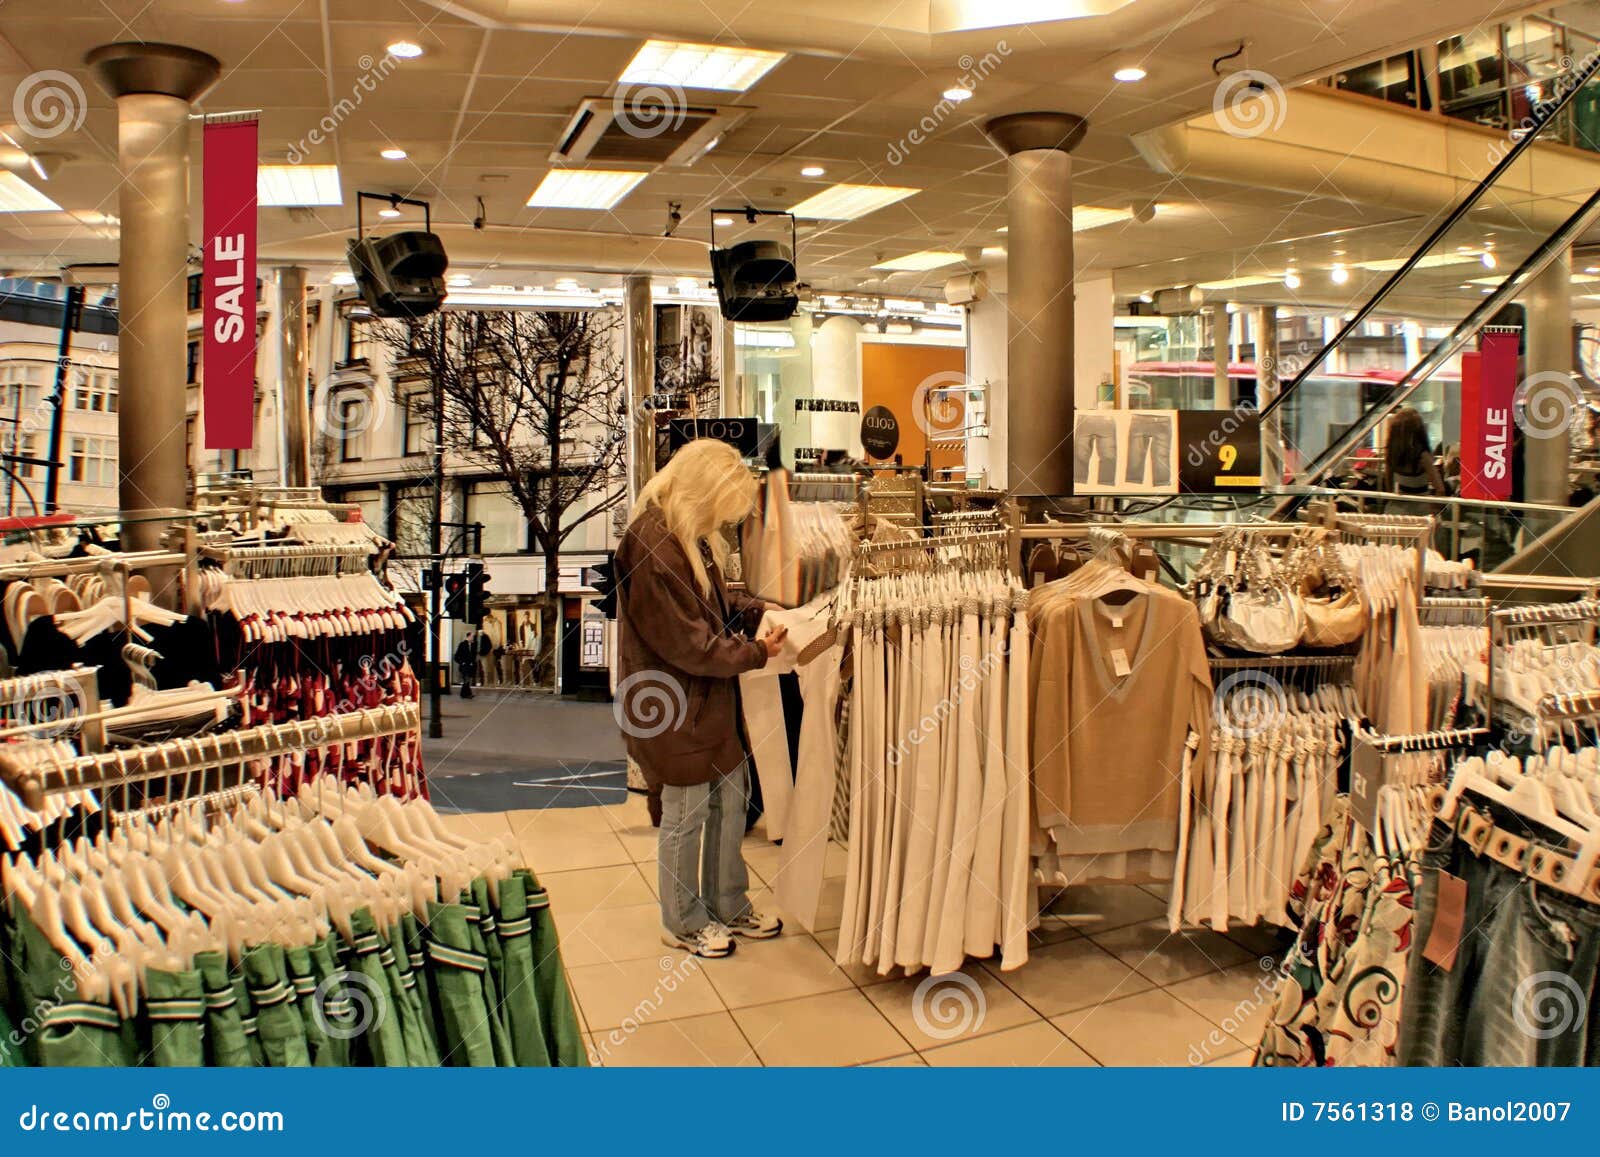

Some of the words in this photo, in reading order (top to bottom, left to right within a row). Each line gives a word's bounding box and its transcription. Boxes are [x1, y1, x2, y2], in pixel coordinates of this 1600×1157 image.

[214, 233, 245, 344] SALE
[1218, 444, 1238, 471] 9
[1484, 407, 1508, 480] SALE
